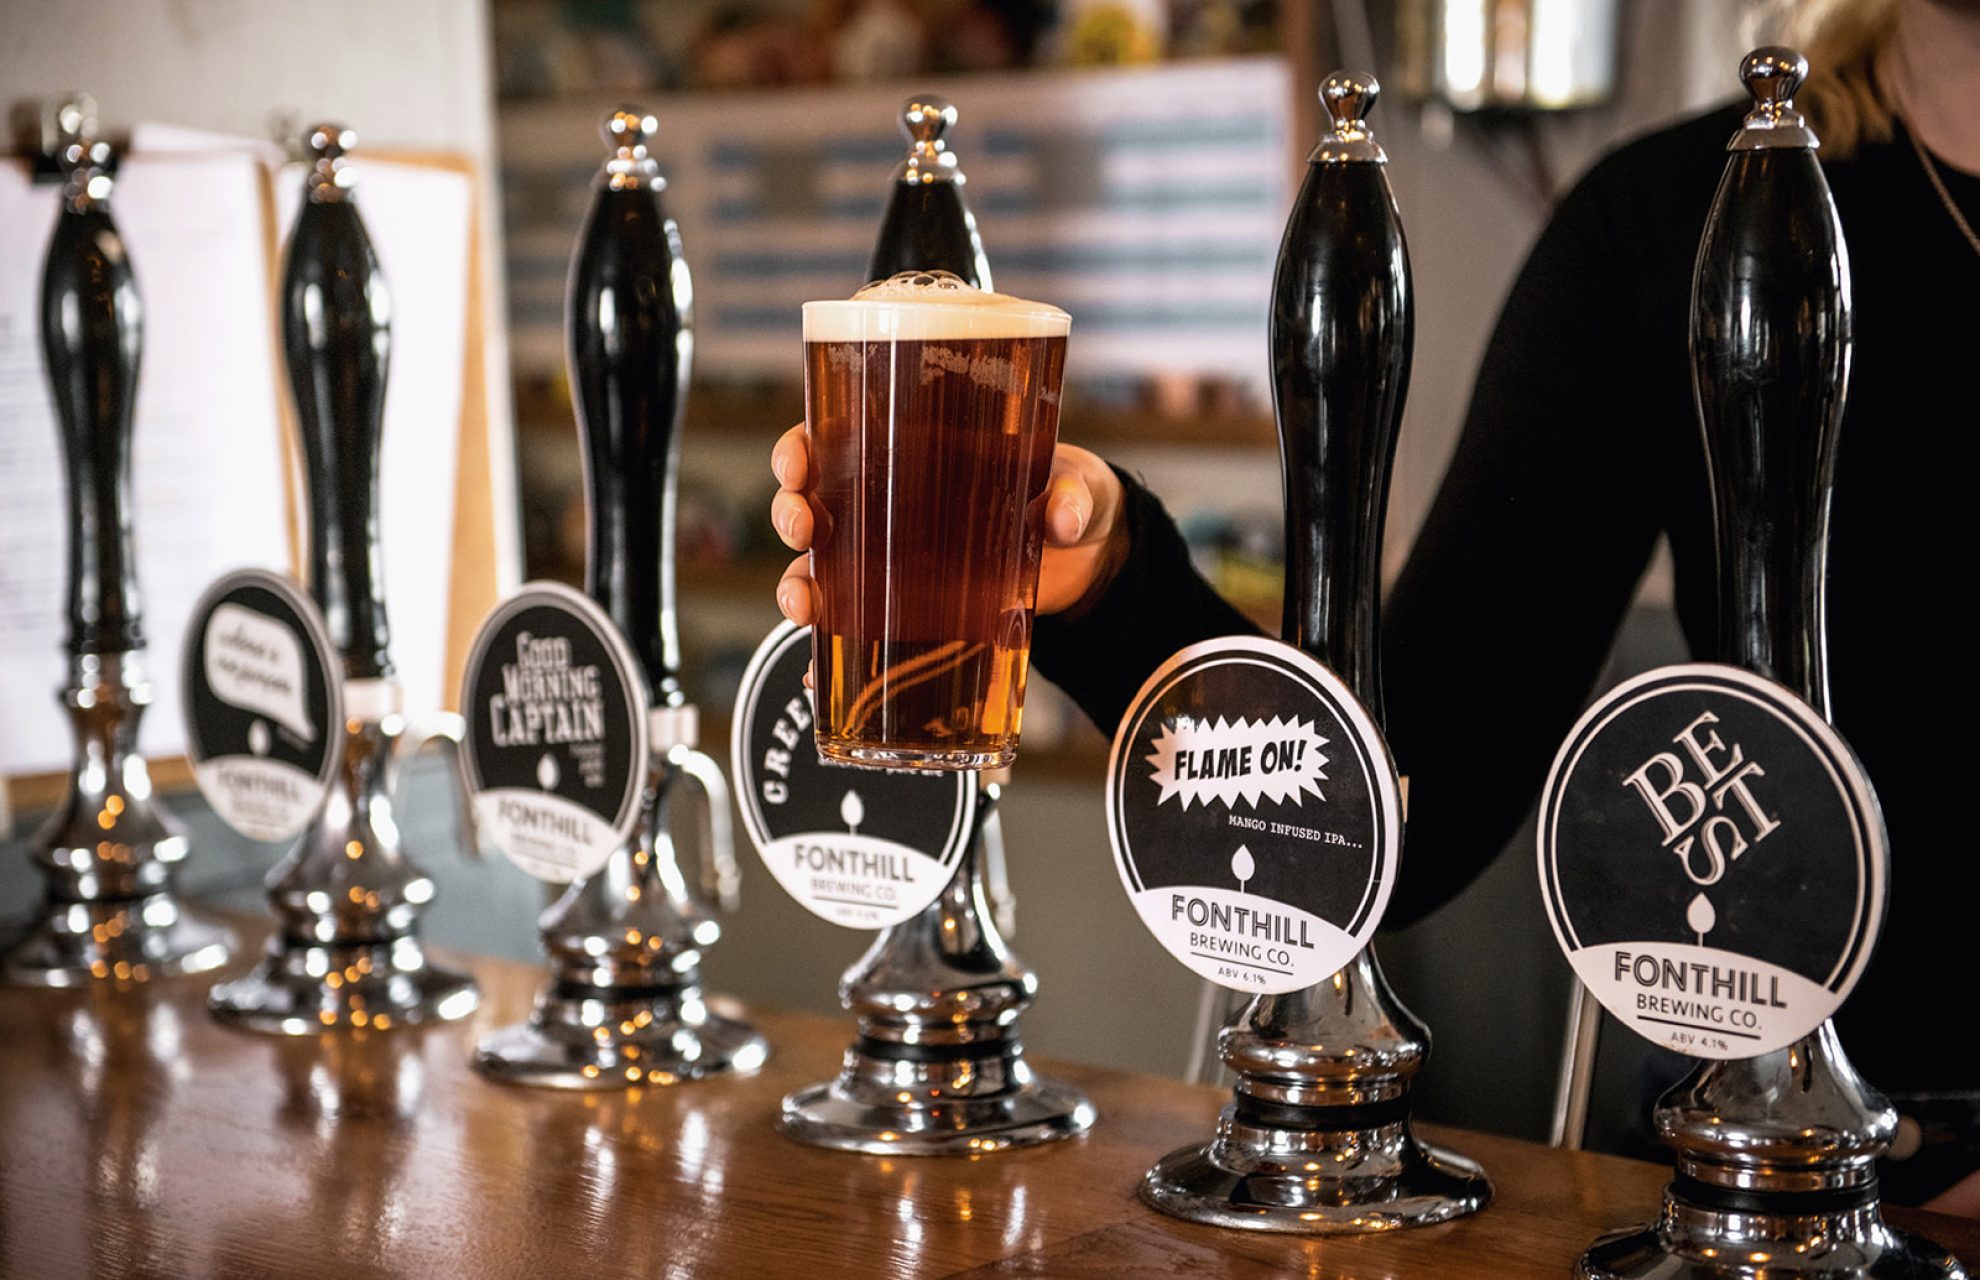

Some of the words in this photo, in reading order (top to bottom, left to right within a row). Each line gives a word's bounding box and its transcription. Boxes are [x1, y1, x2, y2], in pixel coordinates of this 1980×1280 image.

[516, 630, 571, 668] GOOD
[502, 664, 601, 700] MORNING
[489, 692, 606, 747] CAPTAIN
[1174, 745, 1252, 781] FLAME
[1260, 739, 1308, 776] ON!
[498, 799, 593, 846] FONTHILL
[1229, 815, 1267, 832] MANGO
[1270, 822, 1321, 842] INFUSED
[1324, 831, 1363, 849] IPA...
[794, 844, 915, 883] FONTHILL
[811, 877, 870, 898] BREWING
[1171, 894, 1315, 950] FONTHILL
[1190, 932, 1262, 961] BREWING
[1267, 948, 1294, 968] CO.
[1218, 967, 1239, 980] ABV
[1243, 972, 1267, 986] 6.1%
[1614, 951, 1788, 1009] FONTHILL
[1636, 993, 1725, 1024] BREWING
[1729, 1008, 1762, 1030] CO.
[1671, 1031, 1696, 1047] ABV
[1700, 1036, 1729, 1051] 4.1%
